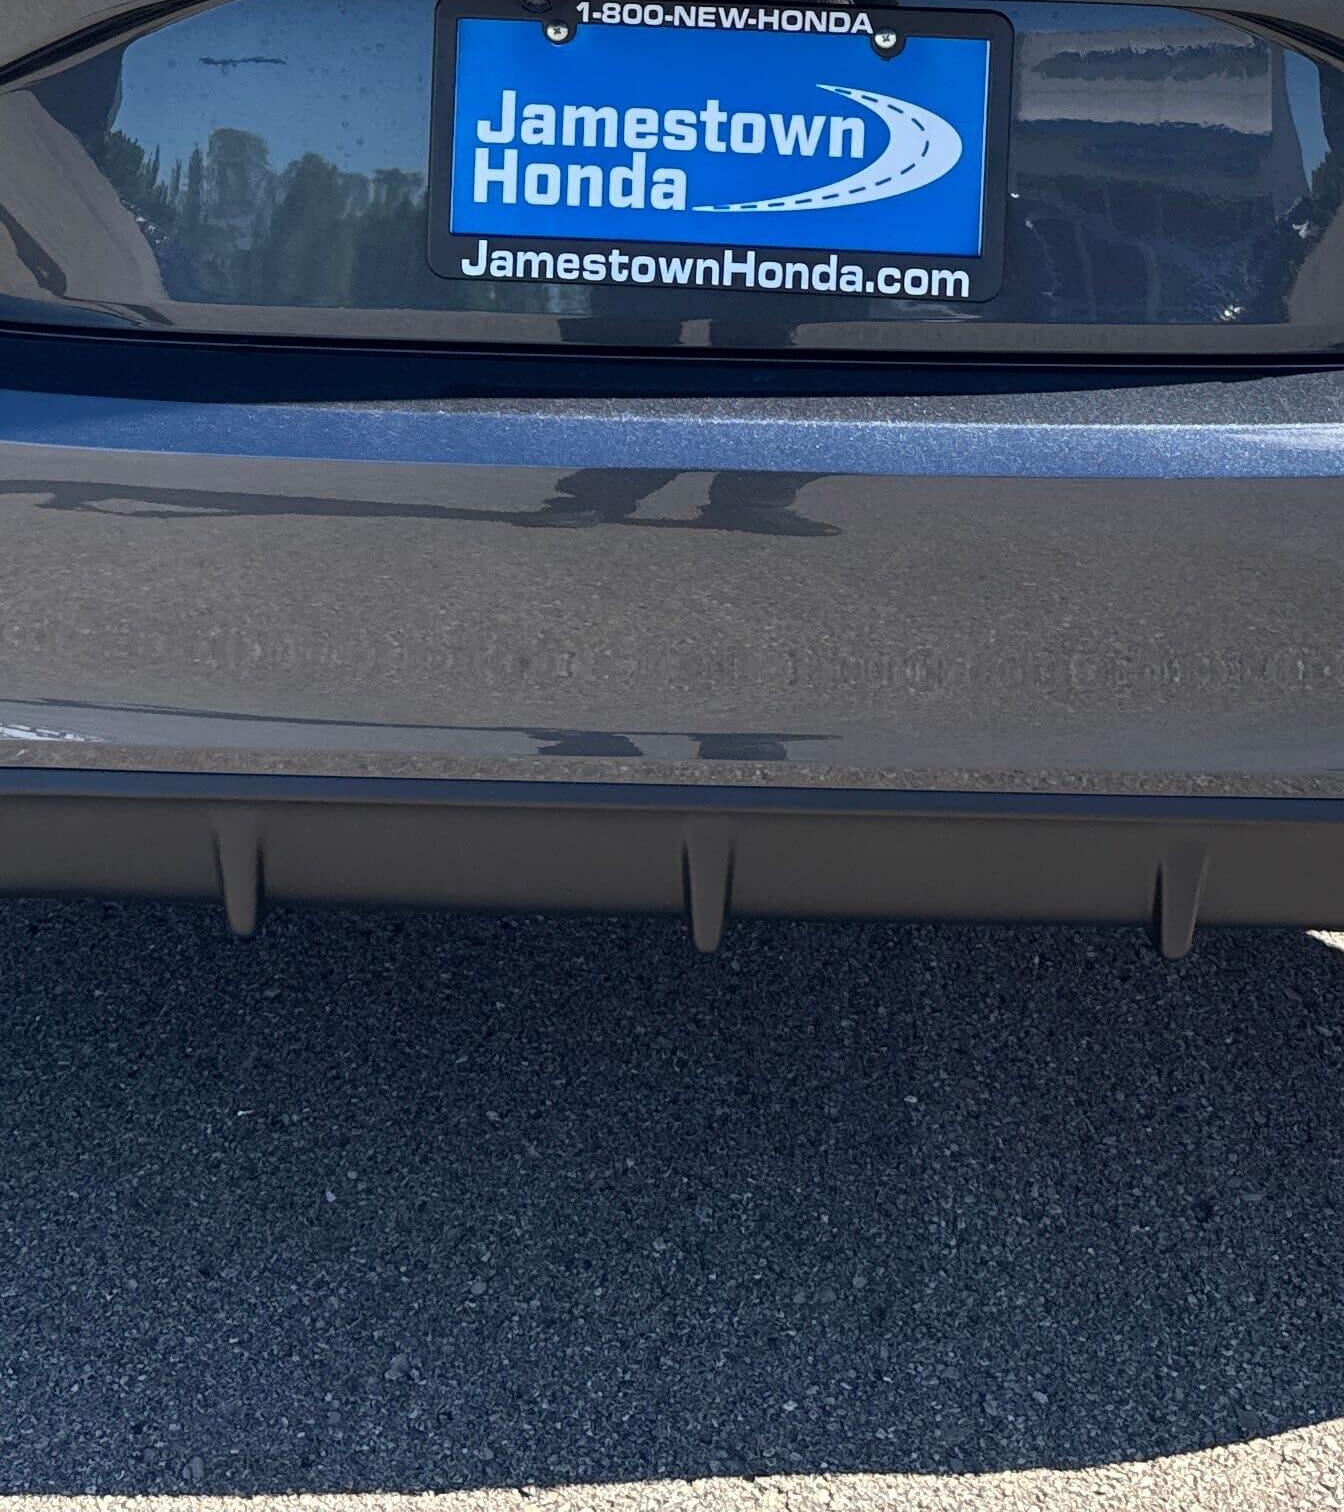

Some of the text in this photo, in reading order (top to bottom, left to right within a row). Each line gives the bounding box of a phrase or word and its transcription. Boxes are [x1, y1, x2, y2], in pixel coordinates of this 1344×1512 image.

[575, 1, 874, 35] 1-800-NEW-HONDA
[476, 89, 865, 159] Jamestown
[472, 148, 688, 211] Honda
[460, 239, 971, 299] JamestownHonda.com
